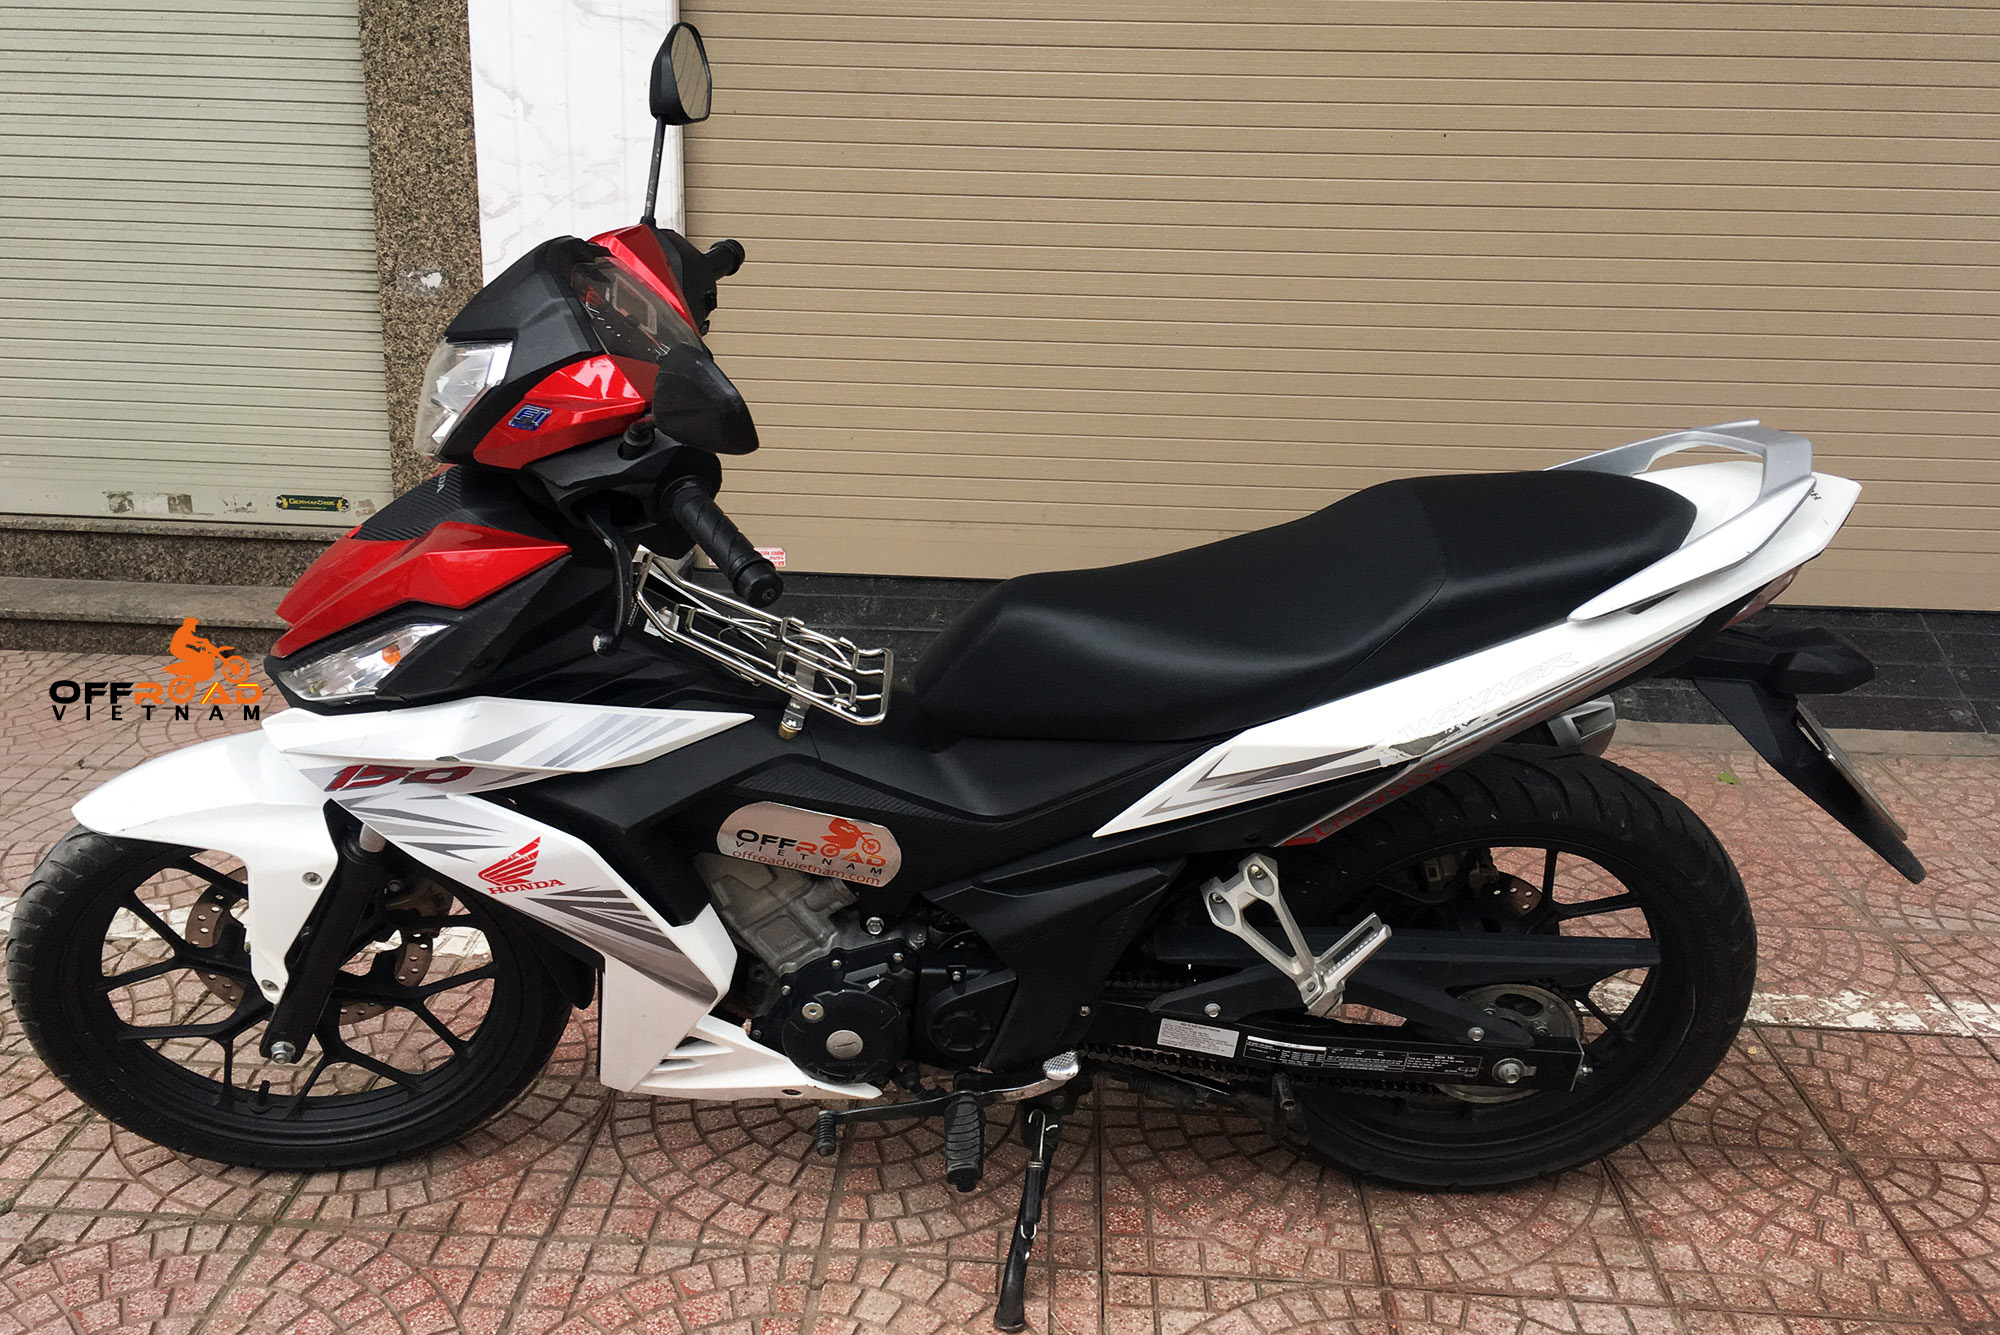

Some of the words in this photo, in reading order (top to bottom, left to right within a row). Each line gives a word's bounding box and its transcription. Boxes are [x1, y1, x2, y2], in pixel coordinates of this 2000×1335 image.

[324, 764, 475, 792] 150
[735, 840, 883, 875] VIETNAM
[736, 829, 887, 867] OFFROAD
[732, 850, 880, 886] offroadvietnam.com
[488, 878, 565, 895] HONDA
